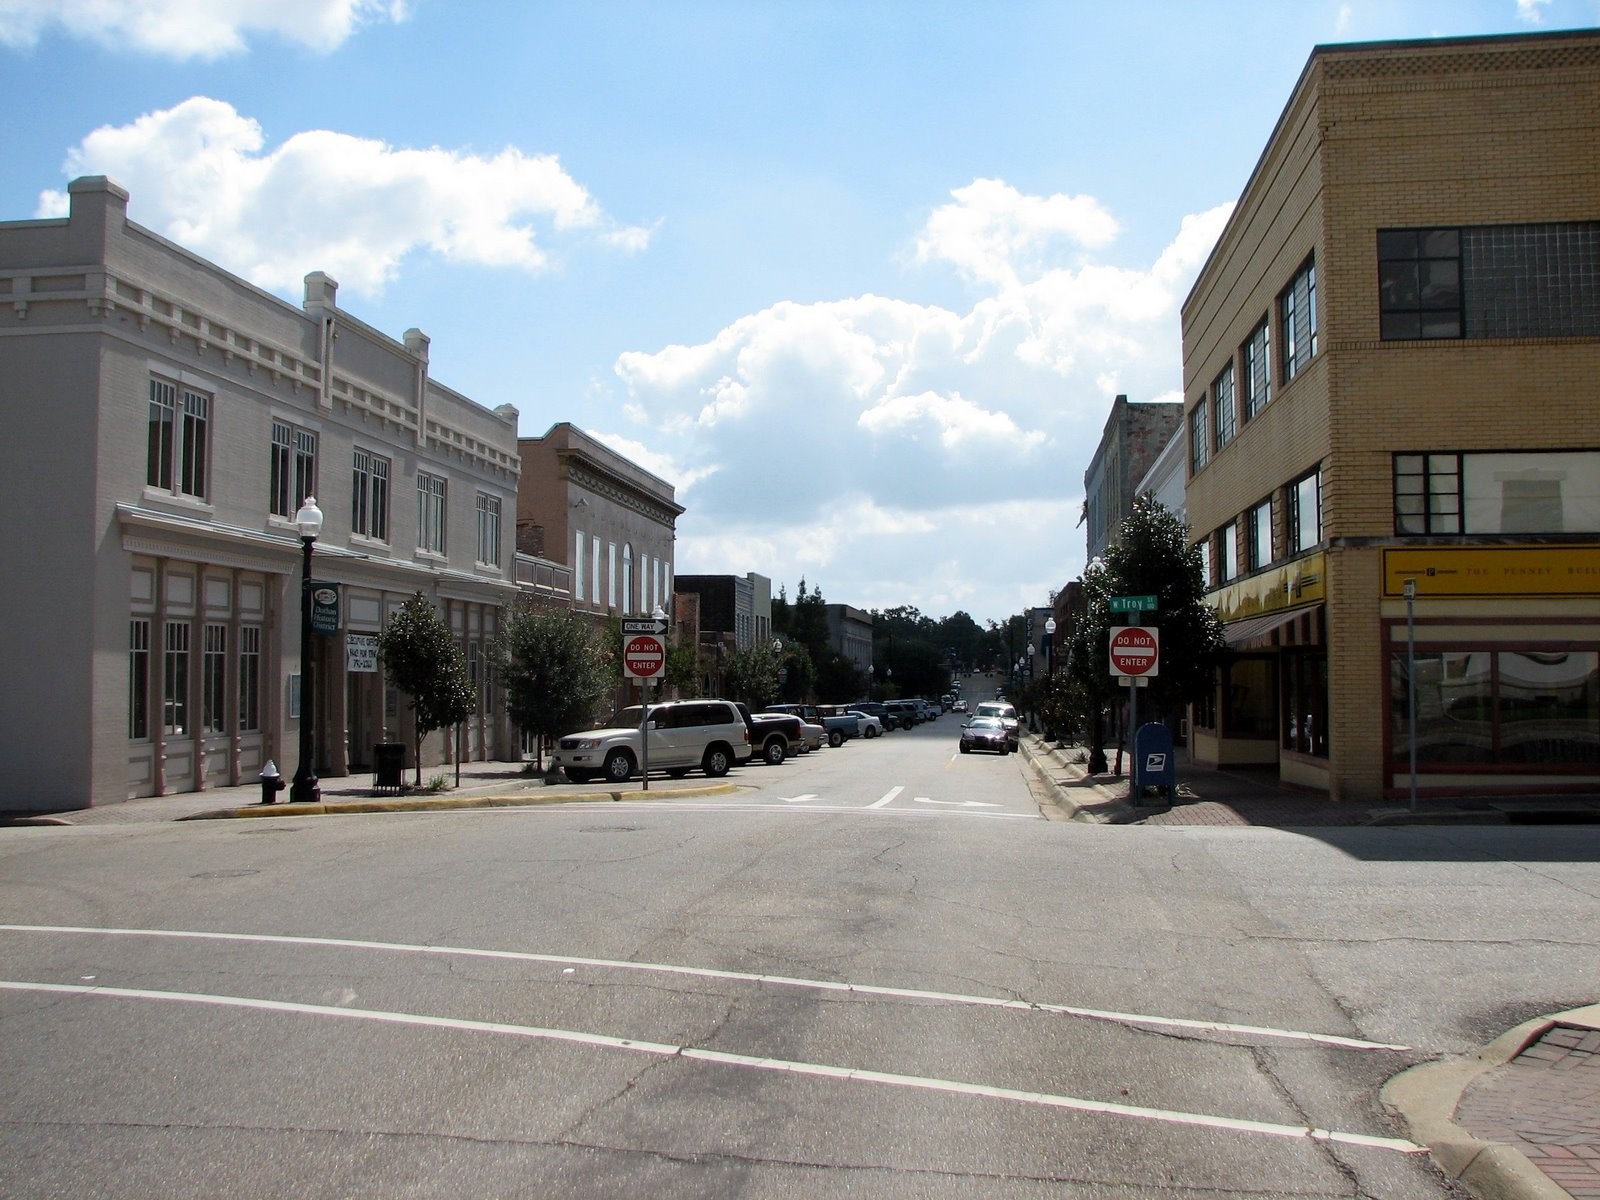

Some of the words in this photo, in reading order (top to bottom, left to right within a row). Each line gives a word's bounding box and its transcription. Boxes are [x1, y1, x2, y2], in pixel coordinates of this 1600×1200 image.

[1467, 567, 1489, 576] THE
[1504, 567, 1552, 576] PENNEY
[1567, 567, 1600, 575] BUIL
[1122, 599, 1142, 610] Troy
[1117, 637, 1130, 645] DO
[1133, 637, 1151, 645] NOT
[1120, 658, 1147, 666] ENTER
